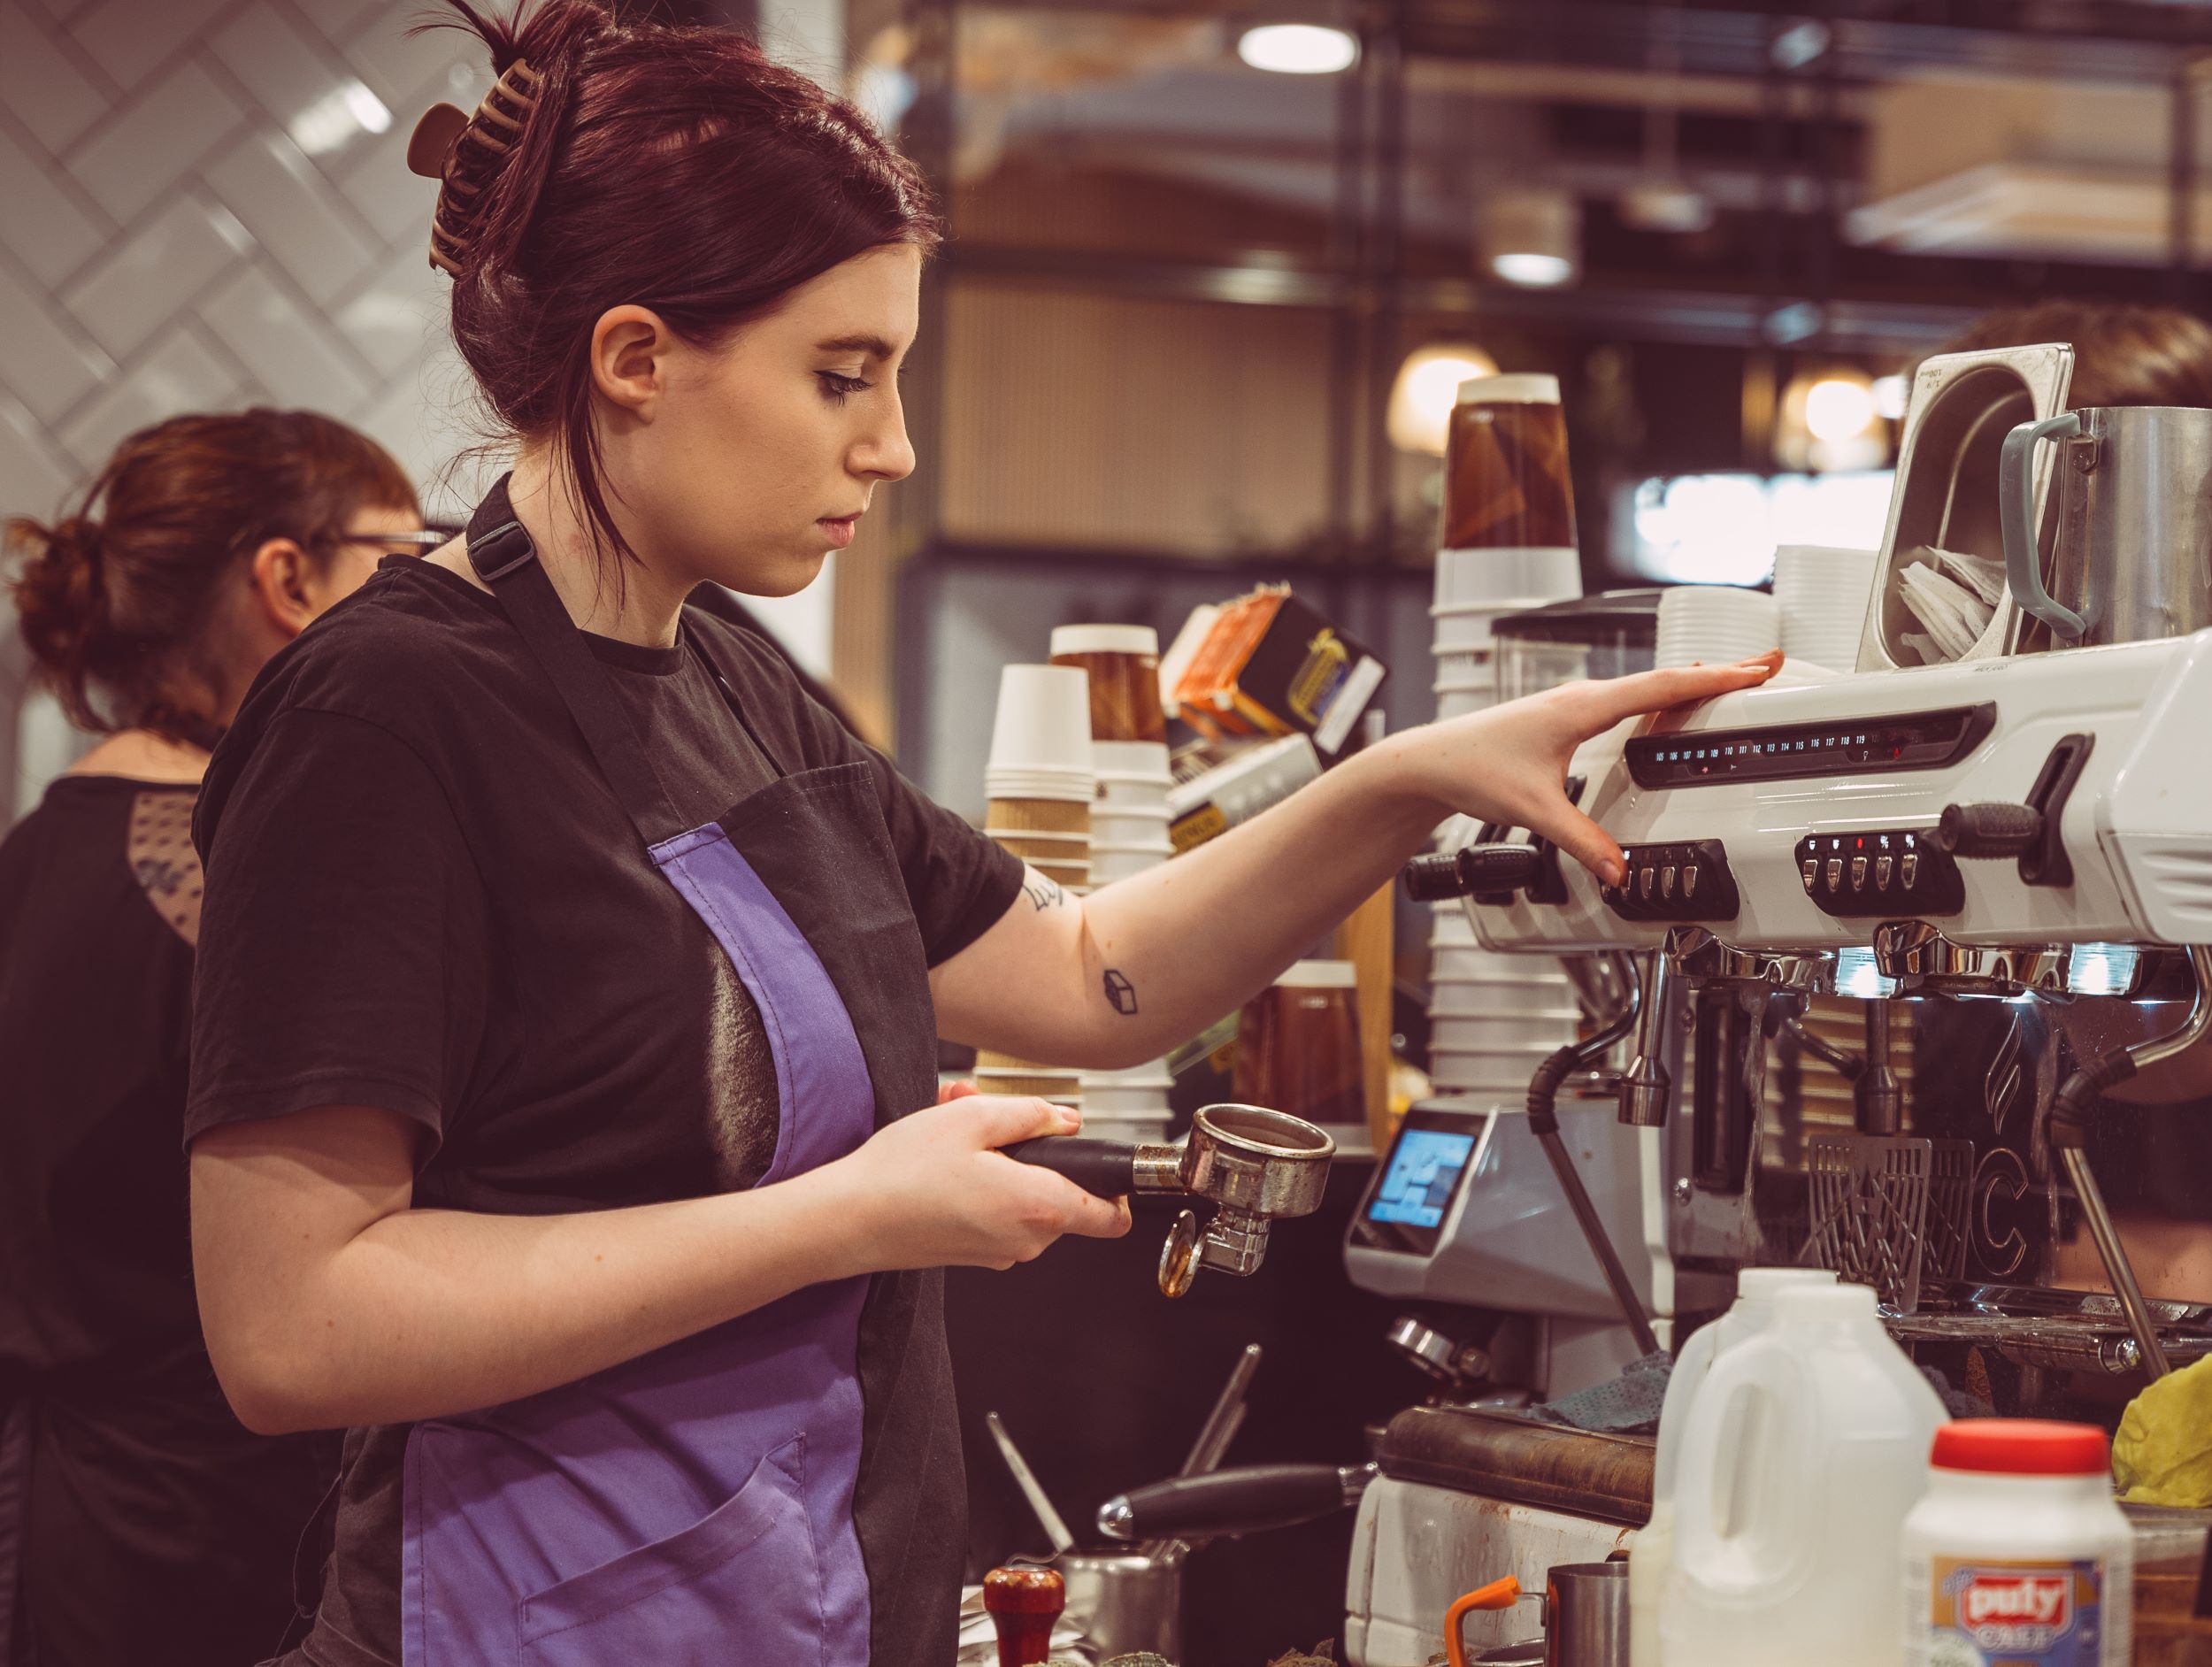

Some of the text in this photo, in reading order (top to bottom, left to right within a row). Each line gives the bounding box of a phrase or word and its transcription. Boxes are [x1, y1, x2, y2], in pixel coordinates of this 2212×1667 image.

[1683, 750, 1692, 760] 107
[1696, 749, 1705, 759] 108
[1710, 749, 1719, 758] 109
[1724, 746, 1733, 756] 110
[1739, 745, 1747, 755] 111
[1752, 743, 1762, 754] 112
[1766, 742, 1776, 753] 113
[1781, 742, 1790, 751] 114
[1795, 741, 1804, 750] 115
[1810, 738, 1820, 748] 116
[1825, 737, 1835, 747] 117
[1840, 735, 1850, 746] 118
[1855, 734, 1865, 744] 119
[1970, 1578, 2062, 1620] puly
